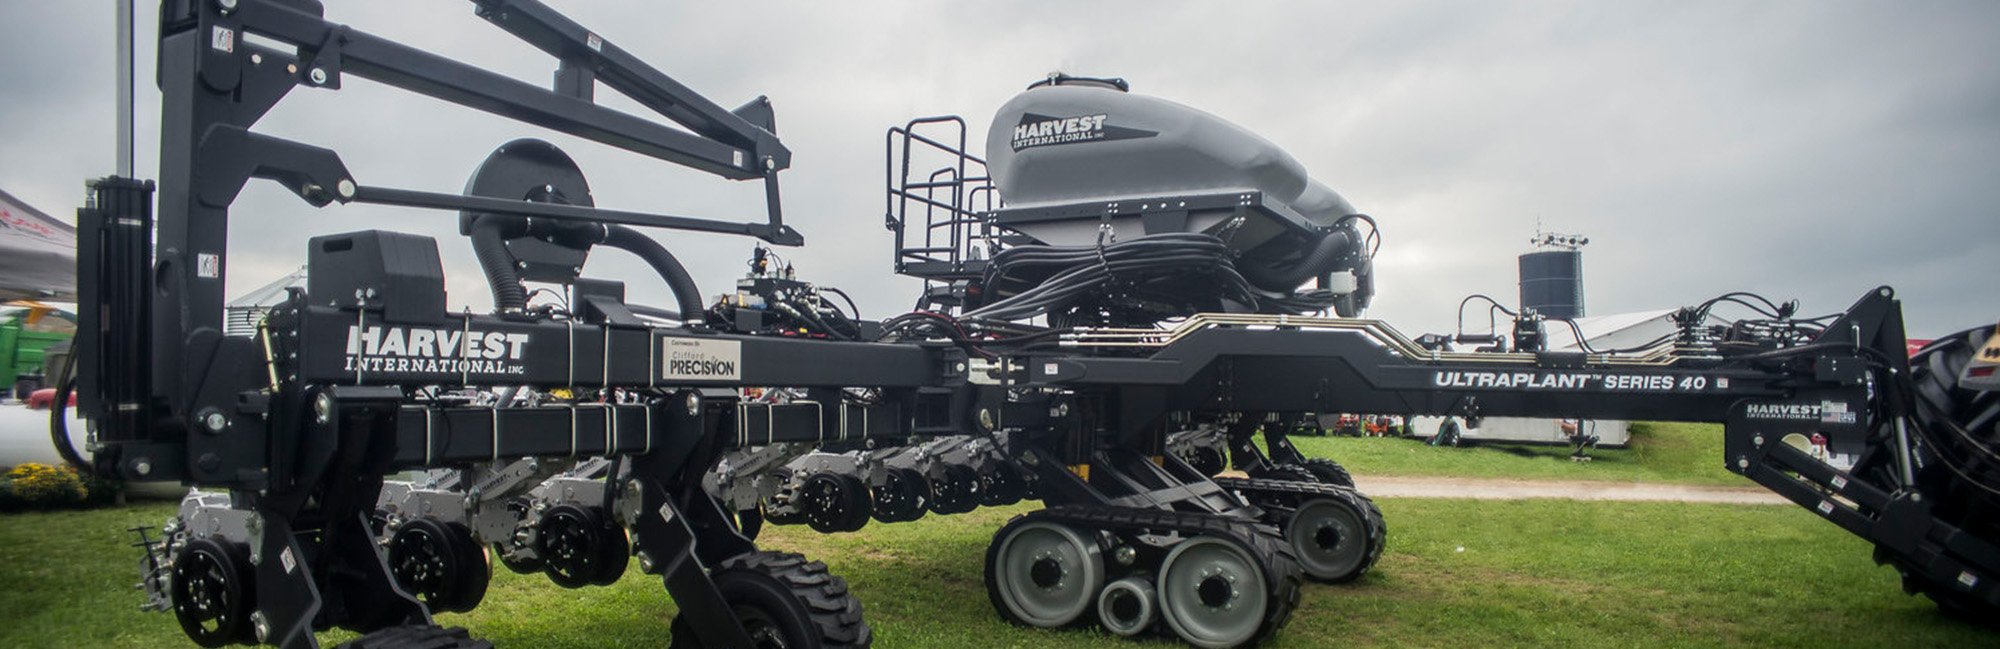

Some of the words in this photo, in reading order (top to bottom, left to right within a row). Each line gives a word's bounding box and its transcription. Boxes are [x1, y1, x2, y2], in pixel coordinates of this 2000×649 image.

[1014, 114, 1107, 140] HARVEST
[1013, 131, 1093, 149] INTERNATIONAL
[346, 325, 529, 360] HARVEST
[344, 356, 506, 374] INTERNATIONAL
[507, 365, 524, 374] INC
[670, 359, 735, 376] PRECISION
[1604, 374, 1674, 389] SERIES
[1679, 376, 1707, 390] 40
[1746, 404, 1821, 415] HARVEST
